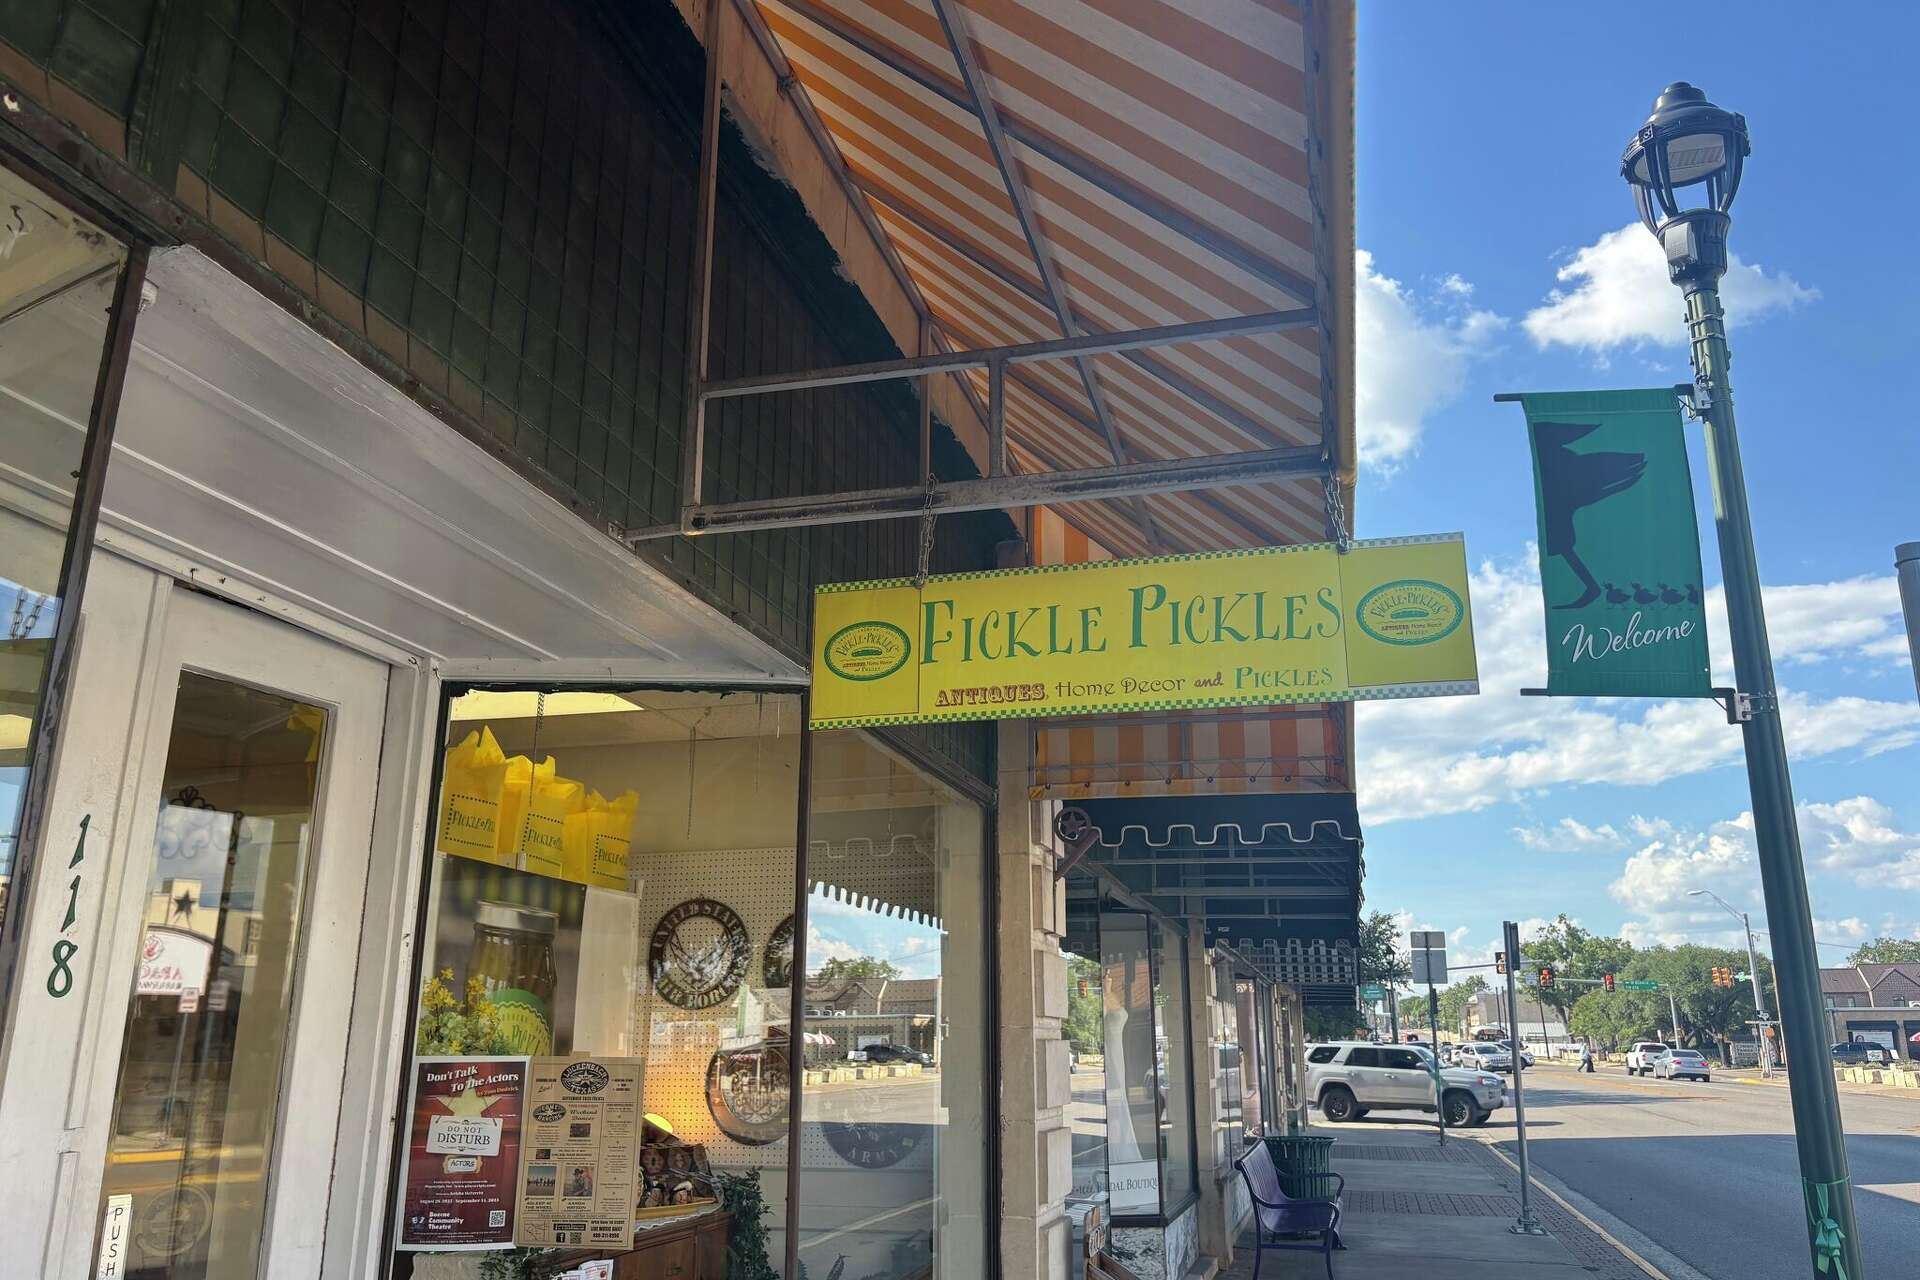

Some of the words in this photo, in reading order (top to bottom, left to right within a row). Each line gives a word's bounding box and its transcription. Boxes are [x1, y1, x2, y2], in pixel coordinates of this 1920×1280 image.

[919, 599, 1106, 664] FICKLE
[1127, 583, 1342, 649] PICKLES
[1562, 611, 1696, 663] Welcome
[1055, 679, 1117, 698] Home
[1120, 675, 1187, 695] Decor
[1194, 672, 1224, 690] and
[1233, 665, 1333, 690] PICKLES
[426, 1070, 453, 1082] Don't
[453, 1064, 479, 1079] Talk
[450, 1082, 465, 1093] To
[464, 1075, 485, 1089] The
[485, 1072, 520, 1084] Actors
[570, 1083, 598, 1095] TEXAS
[446, 1125, 461, 1133] DO
[463, 1126, 483, 1134] NOT
[437, 1132, 491, 1145] DISTURB
[449, 1159, 475, 1168] ACTORS
[846, 1147, 899, 1164] ARMY
[428, 1217, 465, 1225] Community
[105, 1207, 124, 1277] PUSH
